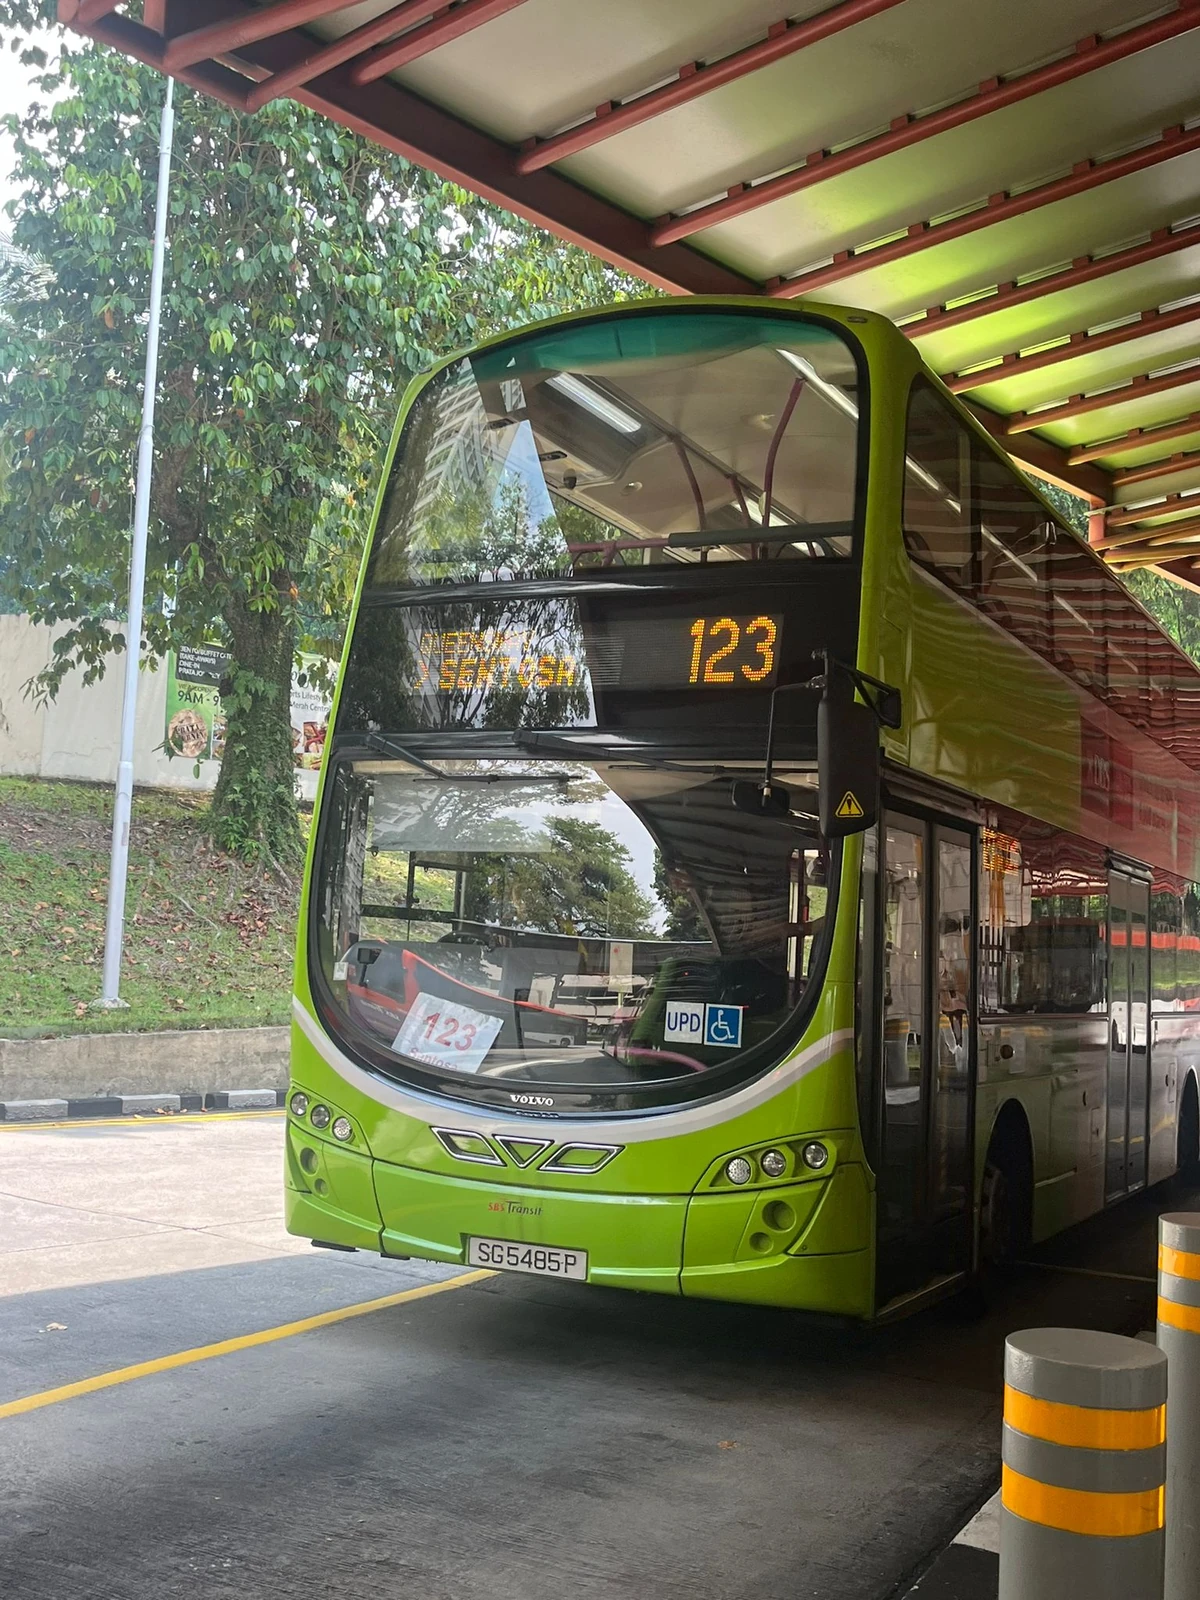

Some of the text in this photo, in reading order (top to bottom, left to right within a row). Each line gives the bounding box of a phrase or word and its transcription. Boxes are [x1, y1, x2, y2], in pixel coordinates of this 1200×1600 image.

[689, 615, 778, 684] 123
[178, 659, 201, 669] DINE-IN
[439, 654, 577, 690] SENTOSA
[178, 690, 203, 704] 9AM
[424, 1012, 477, 1051] 123
[667, 1011, 701, 1032] UPD
[510, 1094, 554, 1106] VOLVO
[488, 1200, 543, 1215] SBS Transit
[478, 1242, 577, 1273] SG5485P
